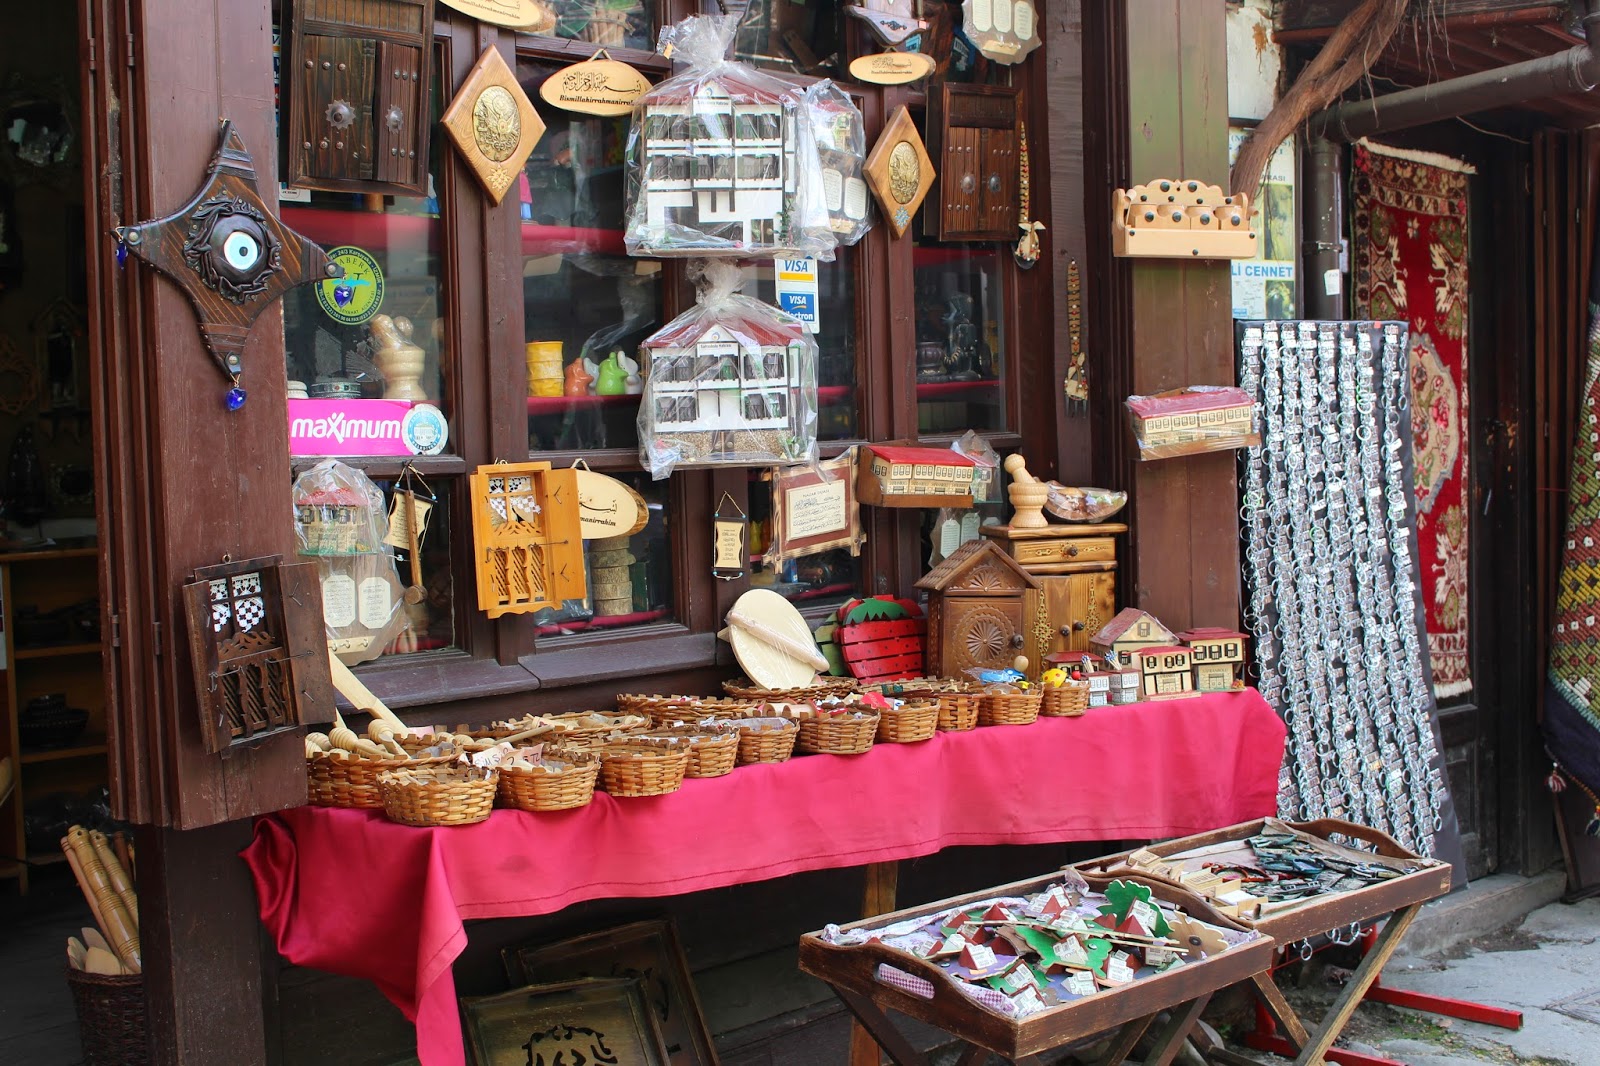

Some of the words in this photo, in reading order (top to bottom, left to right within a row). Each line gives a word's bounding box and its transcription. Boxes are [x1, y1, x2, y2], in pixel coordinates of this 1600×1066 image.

[339, 256, 370, 275] ABERK
[784, 260, 808, 272] VISA
[1245, 266, 1292, 277] CENNET
[789, 296, 806, 304] VISA
